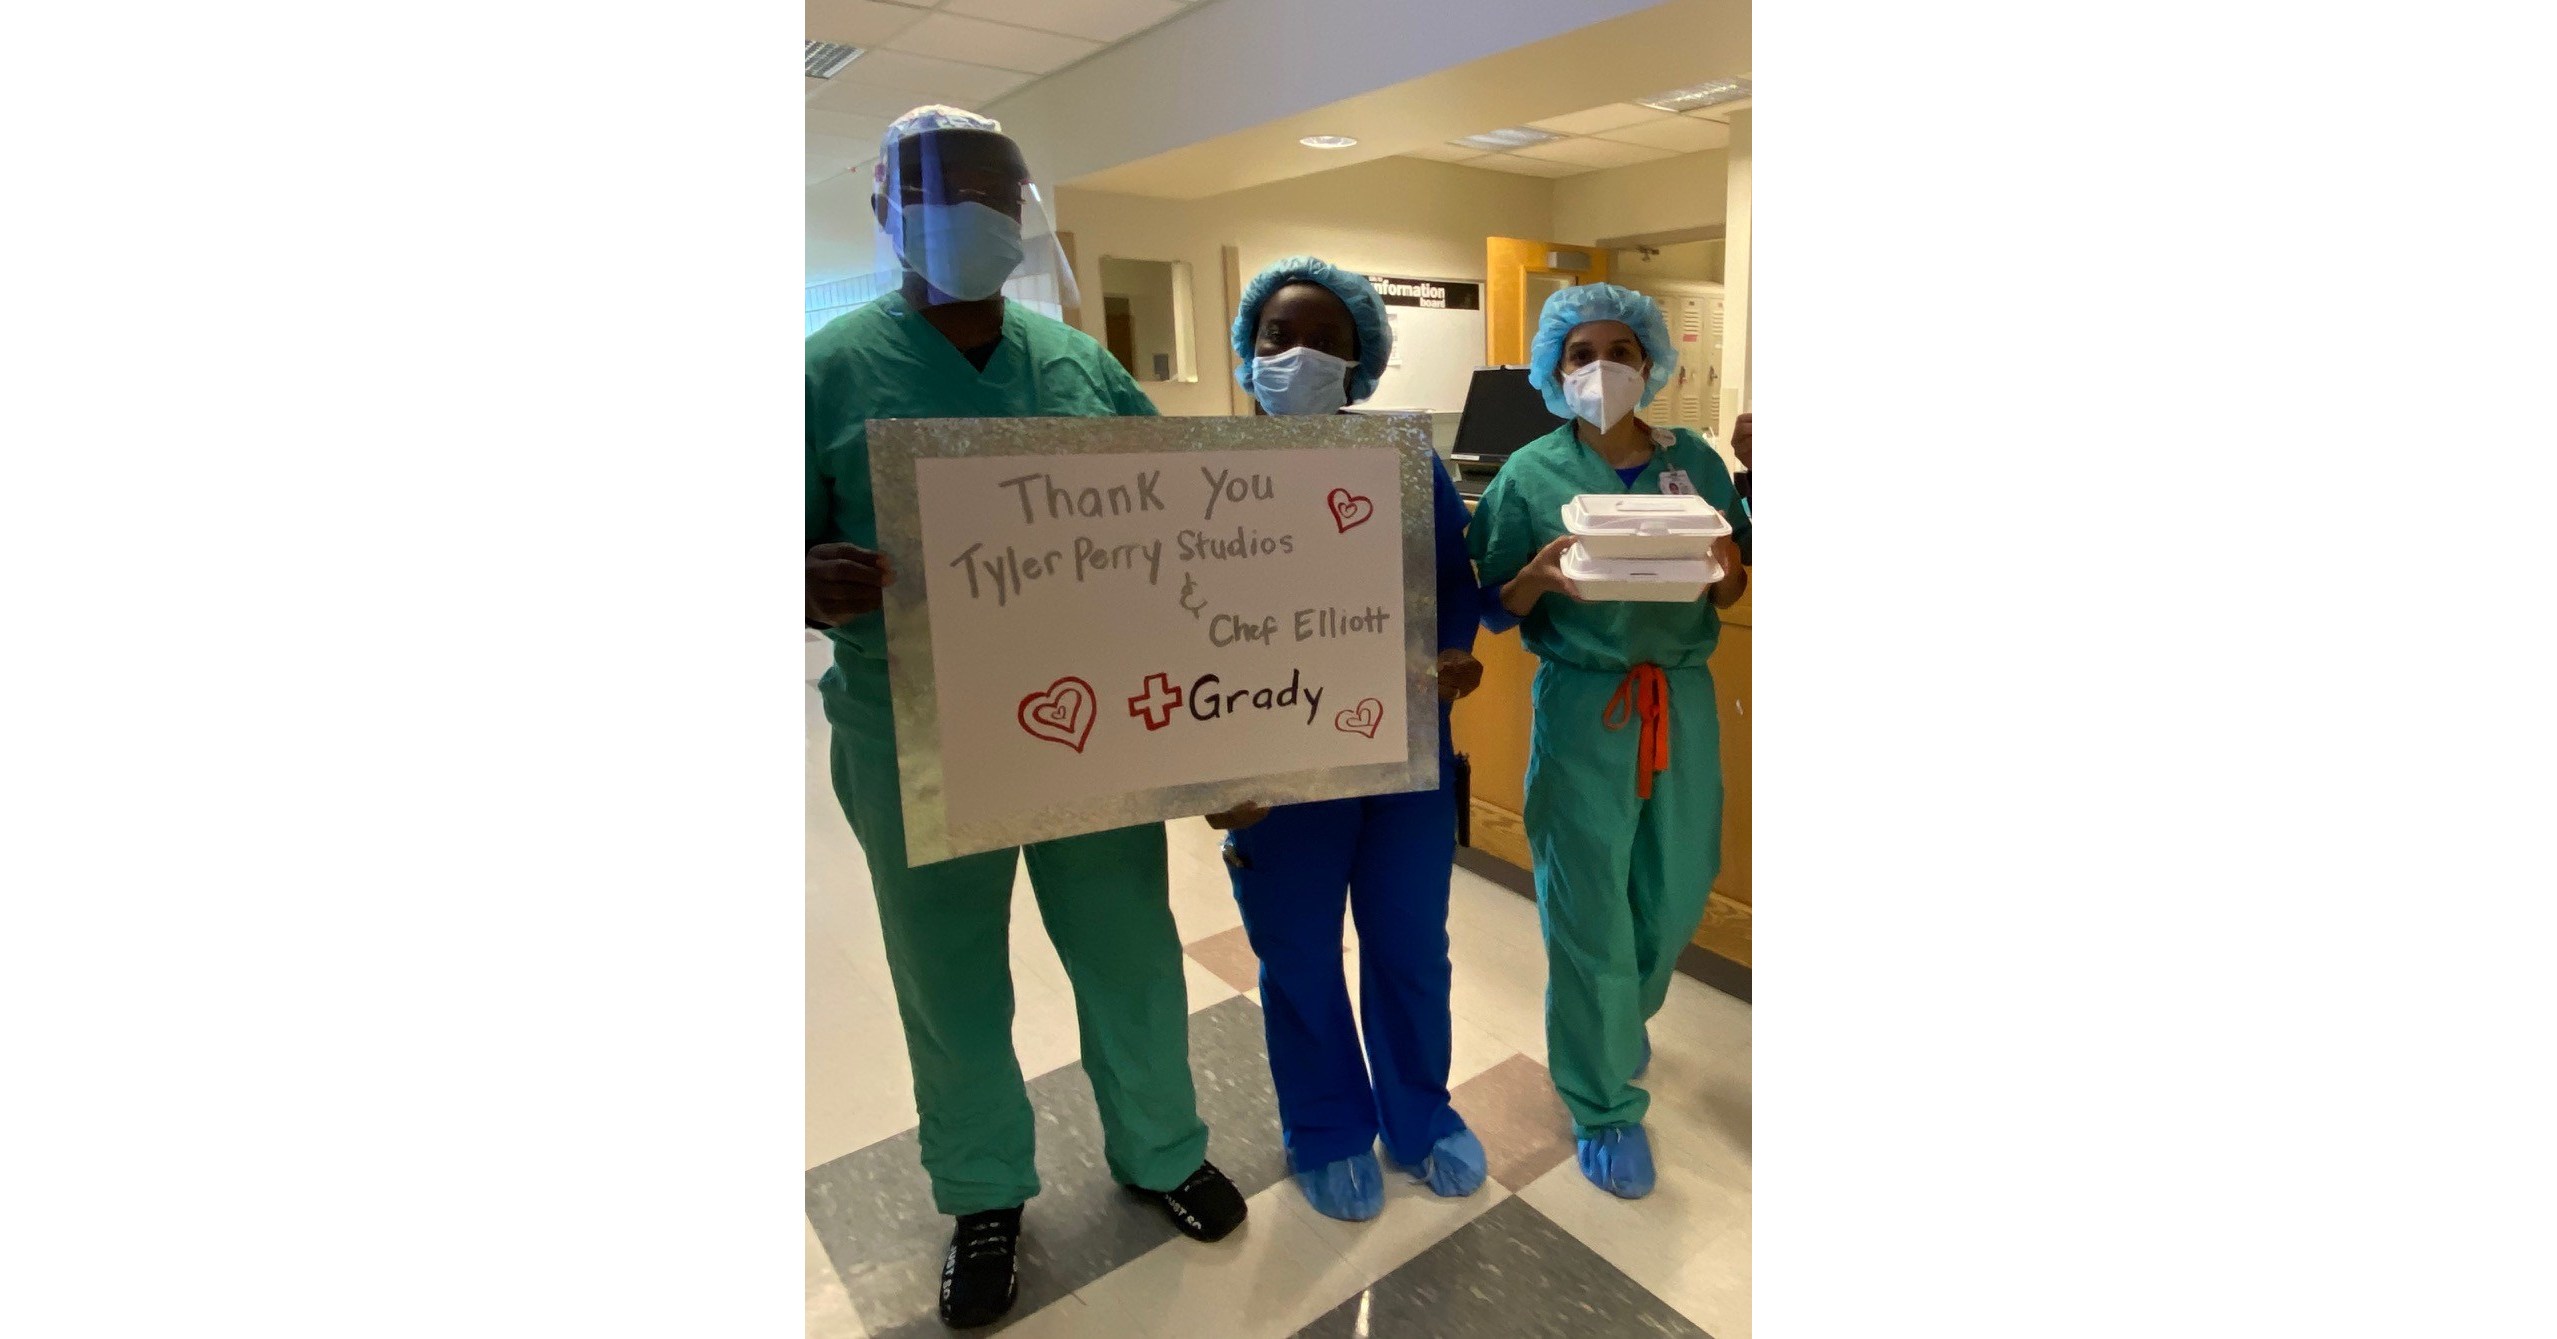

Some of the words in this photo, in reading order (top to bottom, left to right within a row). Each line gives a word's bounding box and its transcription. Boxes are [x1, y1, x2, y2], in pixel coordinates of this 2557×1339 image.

[1371, 279, 1445, 298] nformation
[1420, 297, 1445, 308] board
[1200, 466, 1276, 521] You
[949, 542, 1062, 607] Tyler
[1073, 536, 1164, 586] Perry
[1175, 526, 1295, 562] Studios
[1178, 571, 1208, 620] &
[1208, 613, 1280, 649] Chef
[1293, 605, 1392, 643] Elliott
[1187, 667, 1326, 726] Grady
